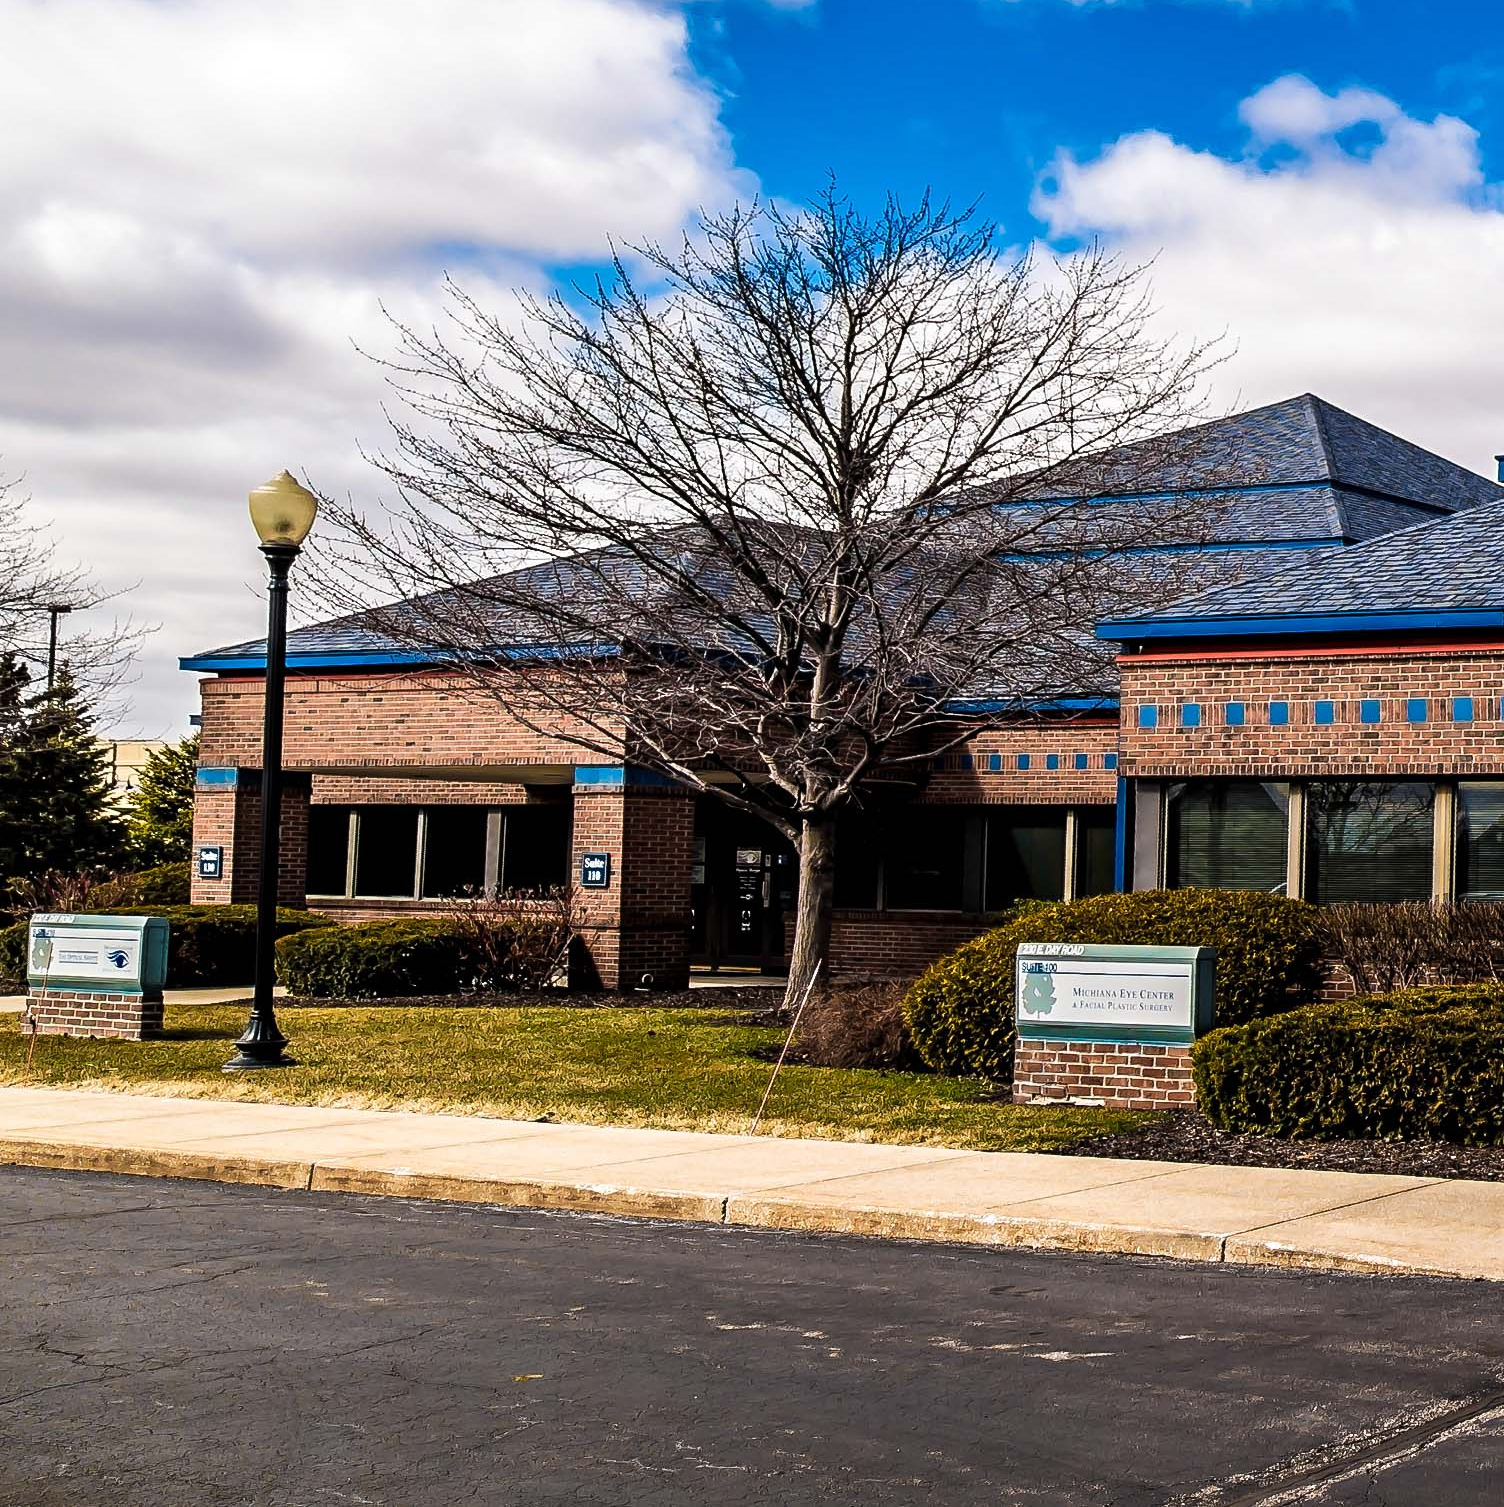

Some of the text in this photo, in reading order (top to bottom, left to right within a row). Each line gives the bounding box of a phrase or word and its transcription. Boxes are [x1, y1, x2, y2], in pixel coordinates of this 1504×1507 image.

[584, 857, 605, 869] Suite
[1022, 944, 1036, 955] 230
[1045, 945, 1061, 955] DAY
[1060, 945, 1085, 955] ROAD
[1072, 987, 1175, 1000] MICHIANA EYE CENTER
[1079, 1000, 1105, 1010] FACIAL
[1107, 1001, 1137, 1011] PLASTIC
[1138, 1002, 1173, 1012] SURGERY
